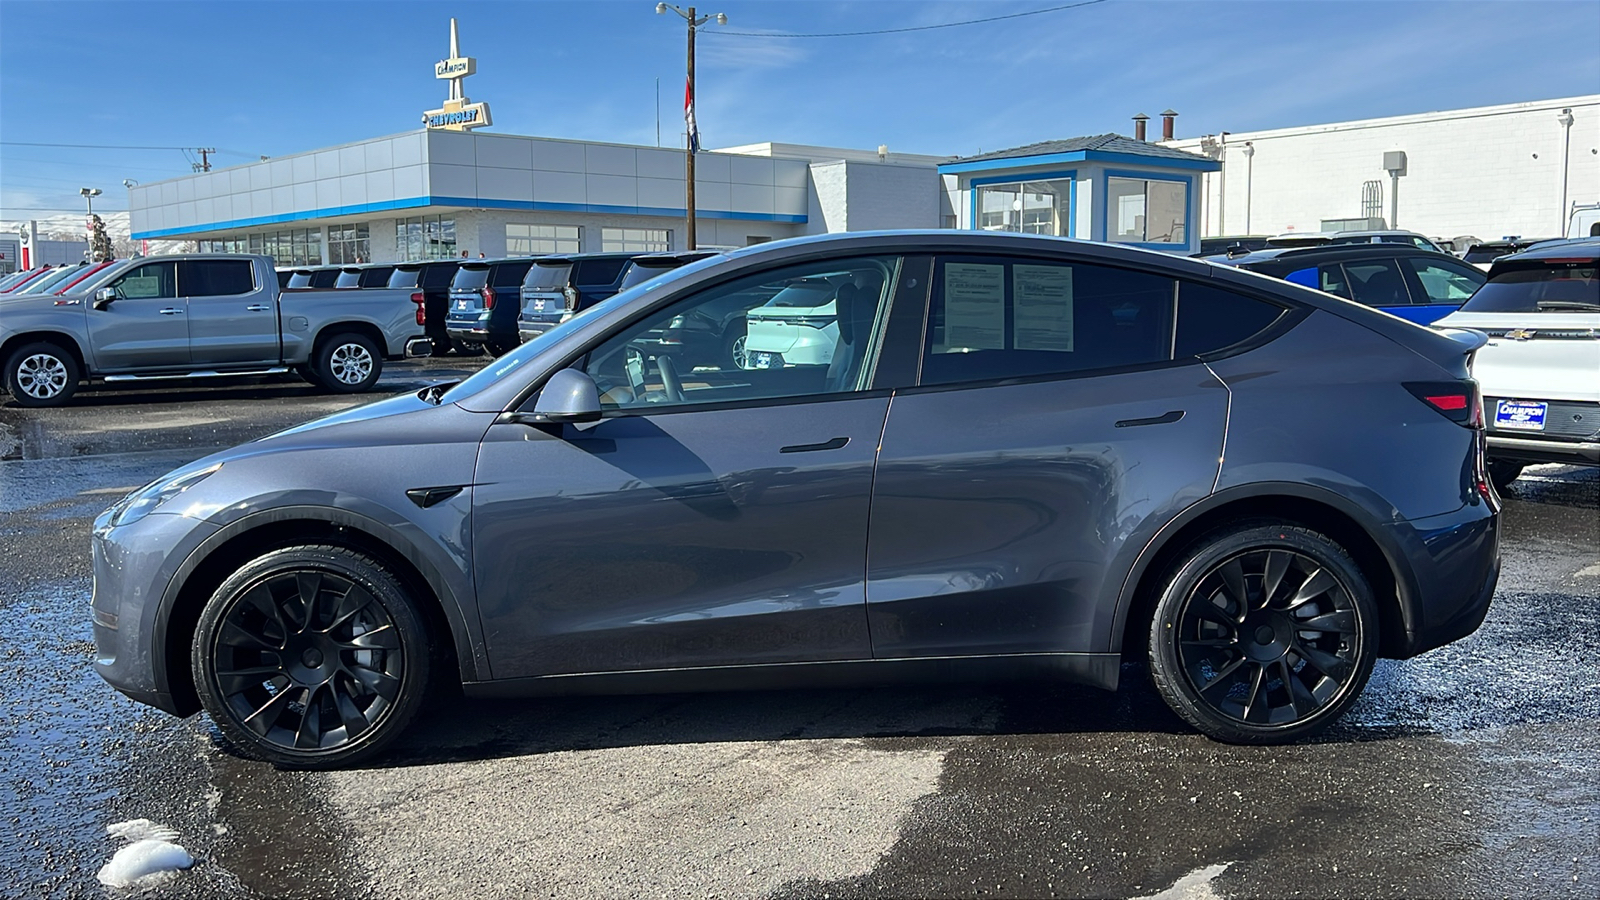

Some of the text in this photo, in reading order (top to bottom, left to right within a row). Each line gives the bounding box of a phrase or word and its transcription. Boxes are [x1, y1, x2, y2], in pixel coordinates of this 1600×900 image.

[438, 62, 466, 75] CHAMPION
[429, 109, 478, 127] CHEVROLET
[1500, 404, 1543, 416] CHAMPION
